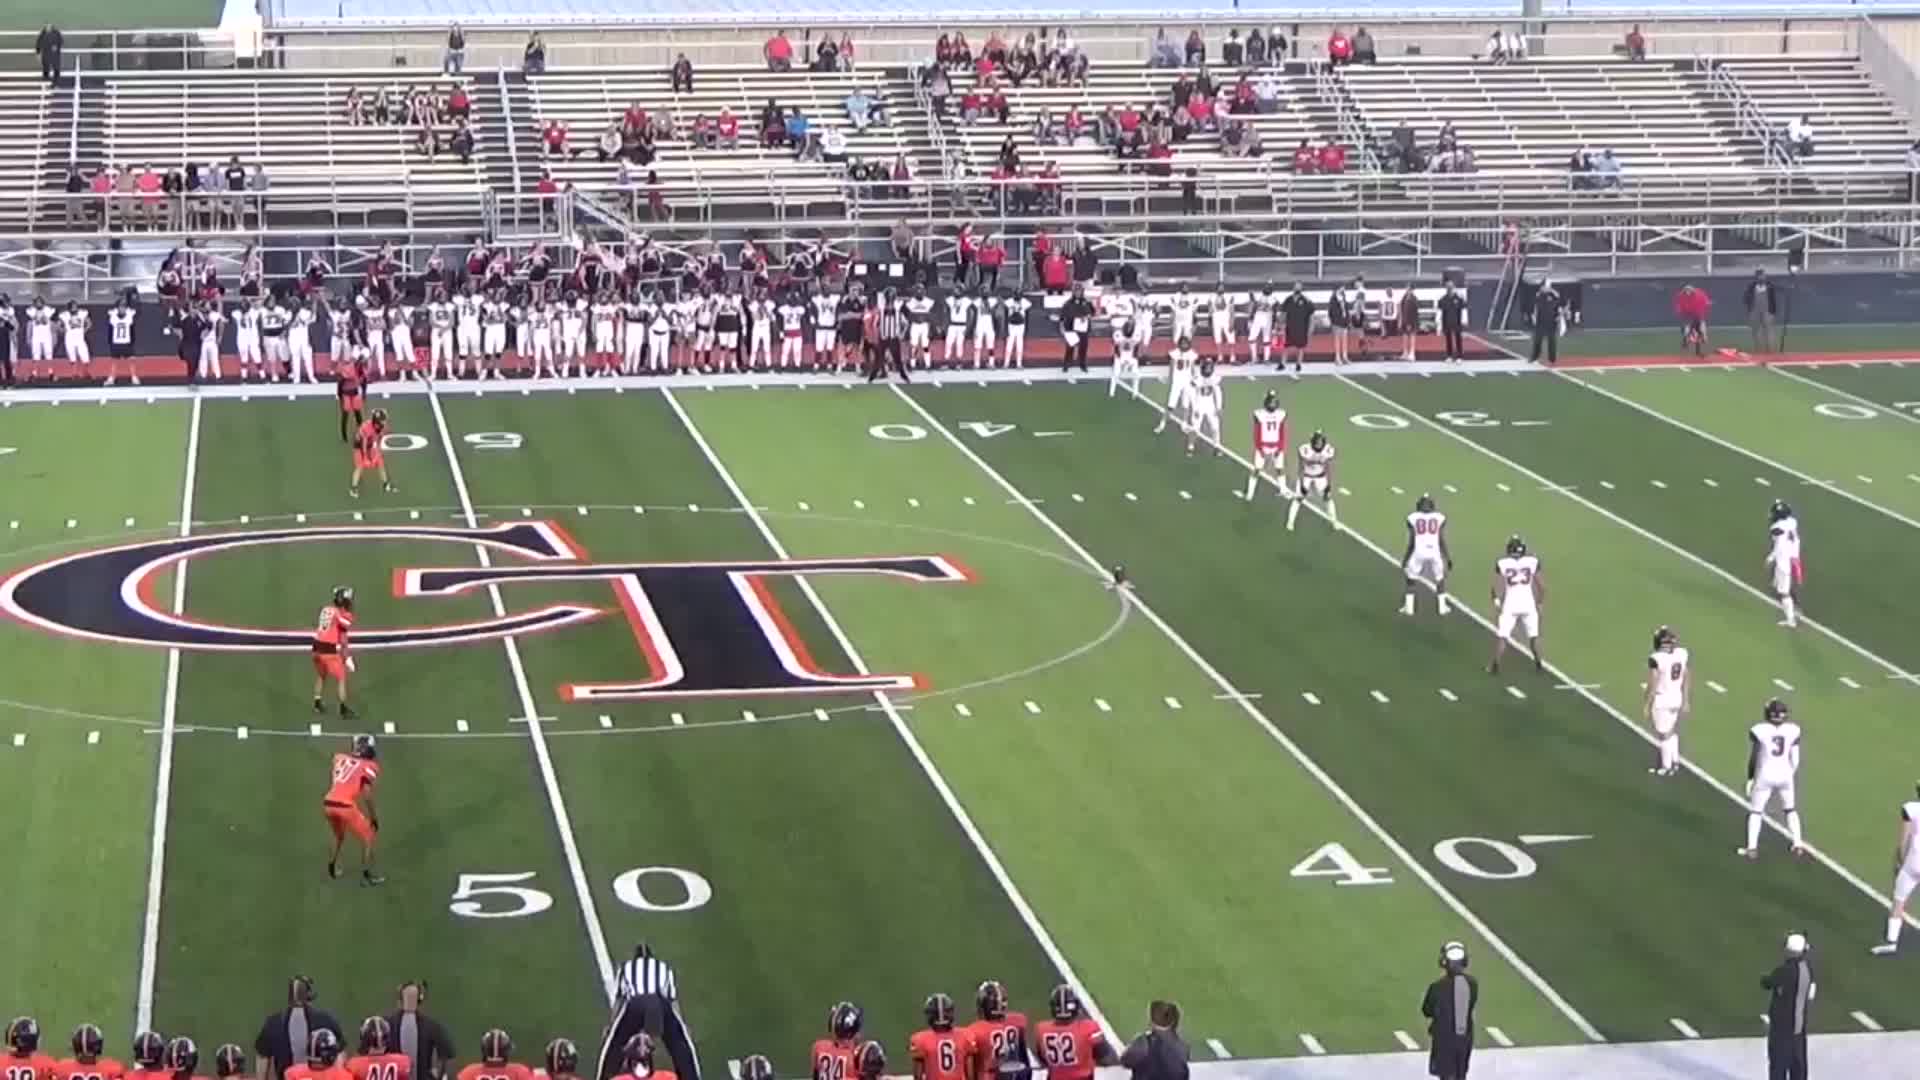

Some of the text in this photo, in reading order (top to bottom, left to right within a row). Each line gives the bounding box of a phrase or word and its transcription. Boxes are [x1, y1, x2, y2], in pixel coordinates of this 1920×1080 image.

[1416, 518, 1438, 535] 80
[1506, 567, 1531, 586] 23
[1771, 736, 1786, 758] 3
[938, 1038, 956, 1073] 6
[1042, 1032, 1077, 1067] 52
